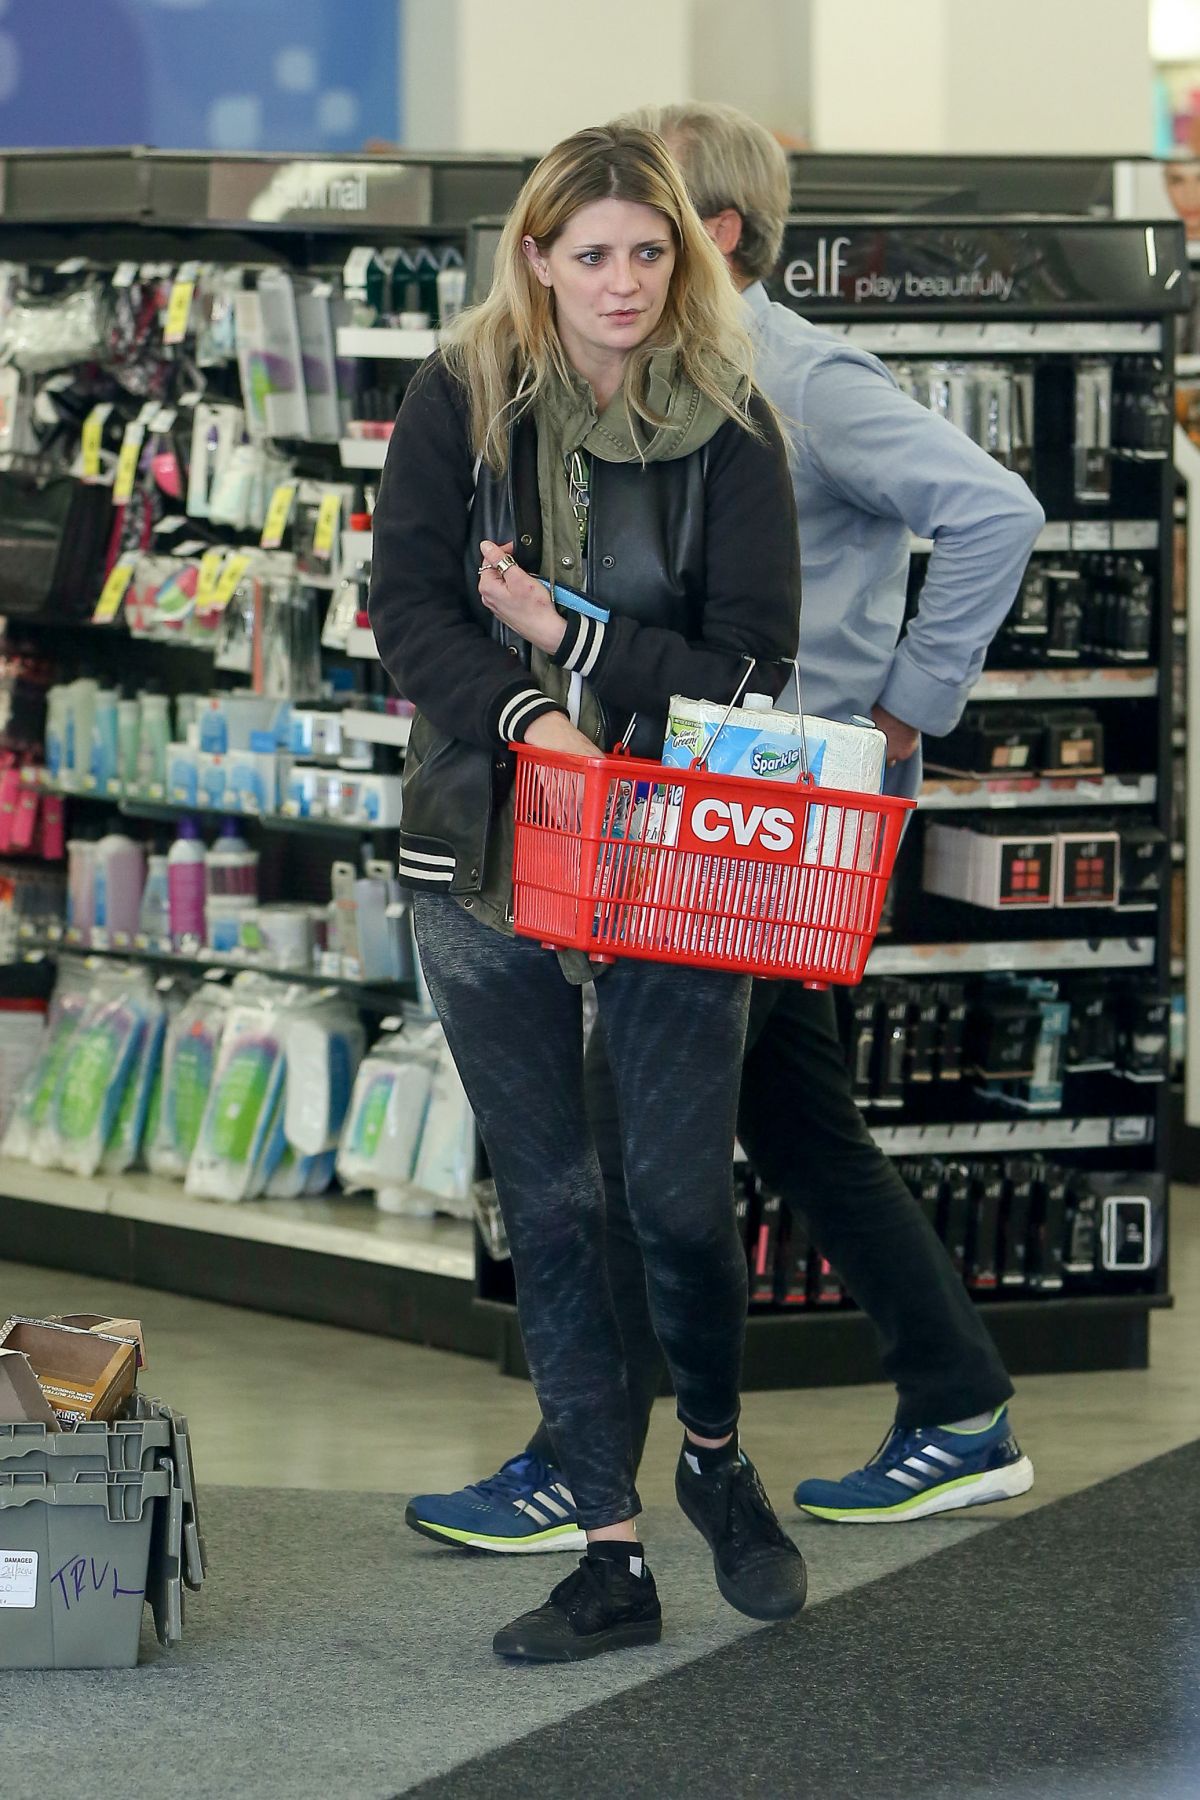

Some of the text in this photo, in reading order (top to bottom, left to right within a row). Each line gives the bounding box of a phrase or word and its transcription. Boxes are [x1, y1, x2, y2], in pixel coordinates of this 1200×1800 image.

[783, 236, 1014, 302] elf play beautifully
[752, 750, 800, 774] Sparkle
[690, 797, 795, 852] CVS
[56, 1409, 77, 1421] KIND
